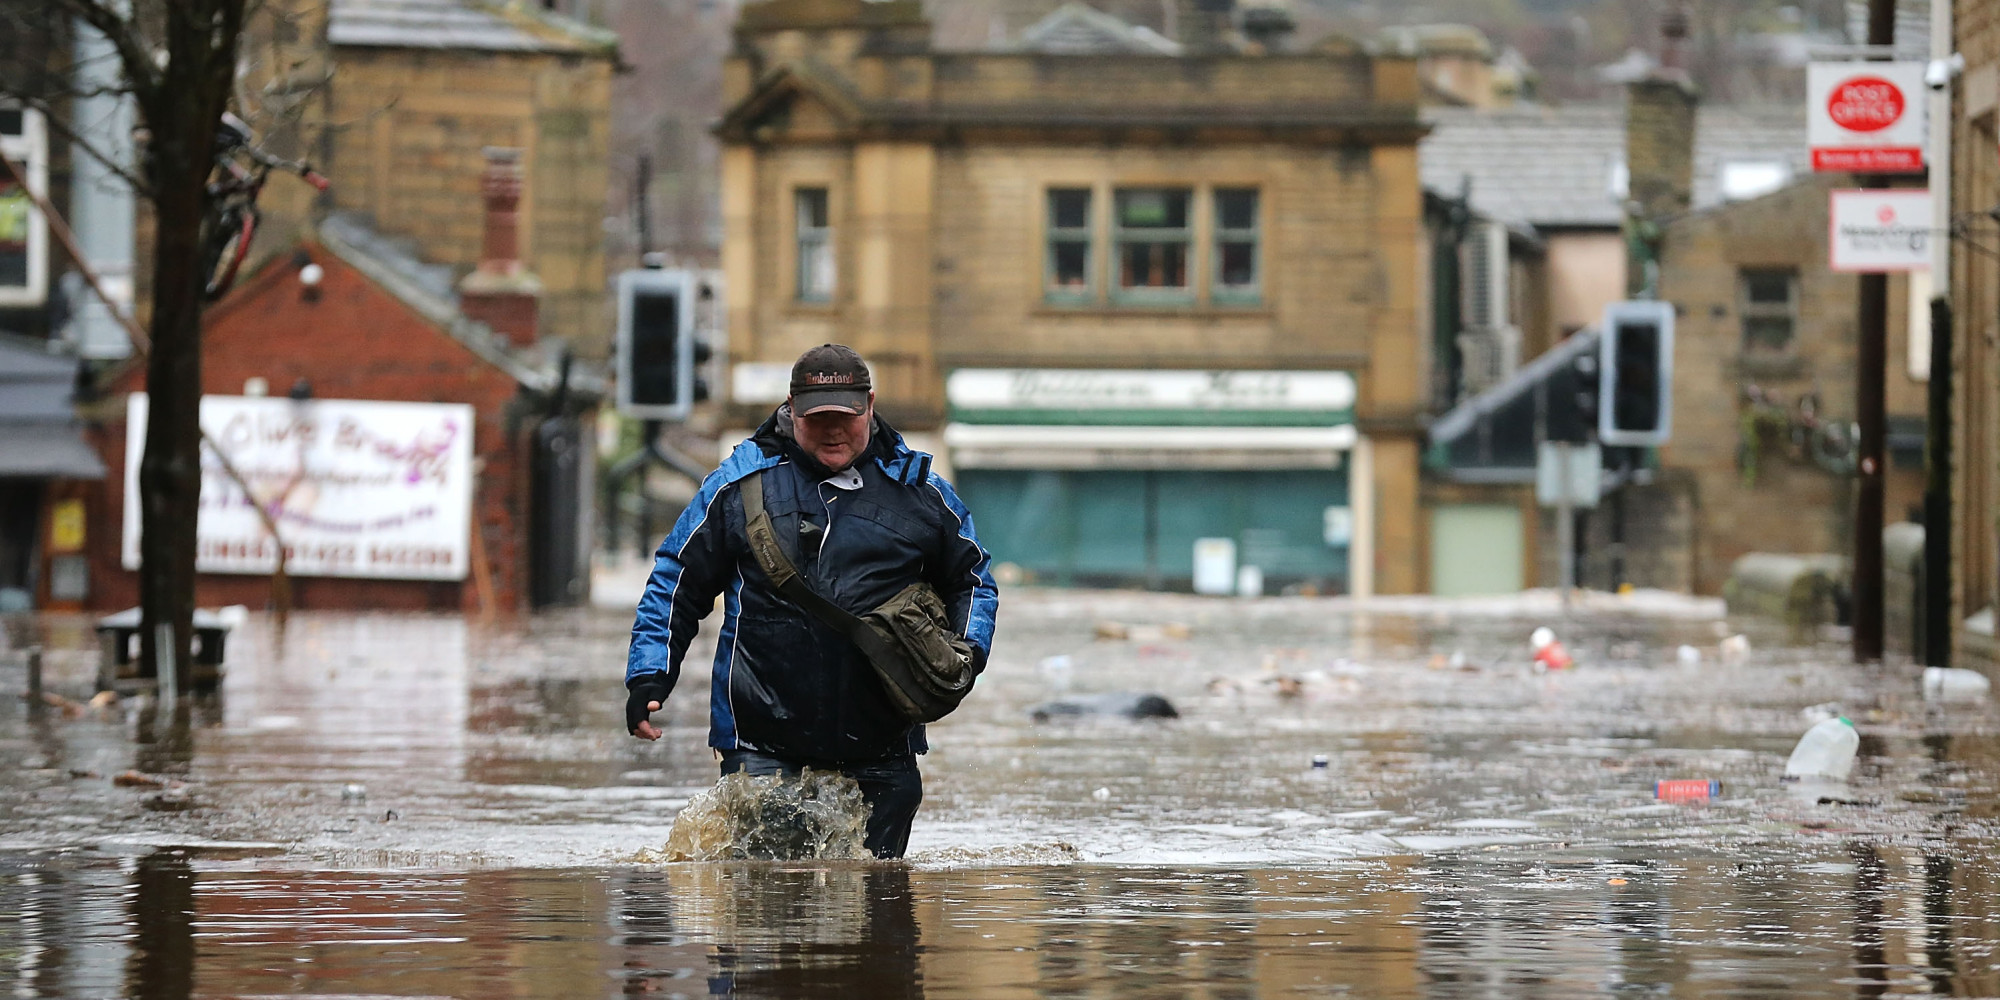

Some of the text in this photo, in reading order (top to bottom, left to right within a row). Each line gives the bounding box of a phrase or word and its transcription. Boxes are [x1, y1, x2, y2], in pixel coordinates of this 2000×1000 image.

[1842, 85, 1890, 101] POST
[1831, 102, 1897, 122] OFFICE
[805, 371, 854, 385] Timberland
